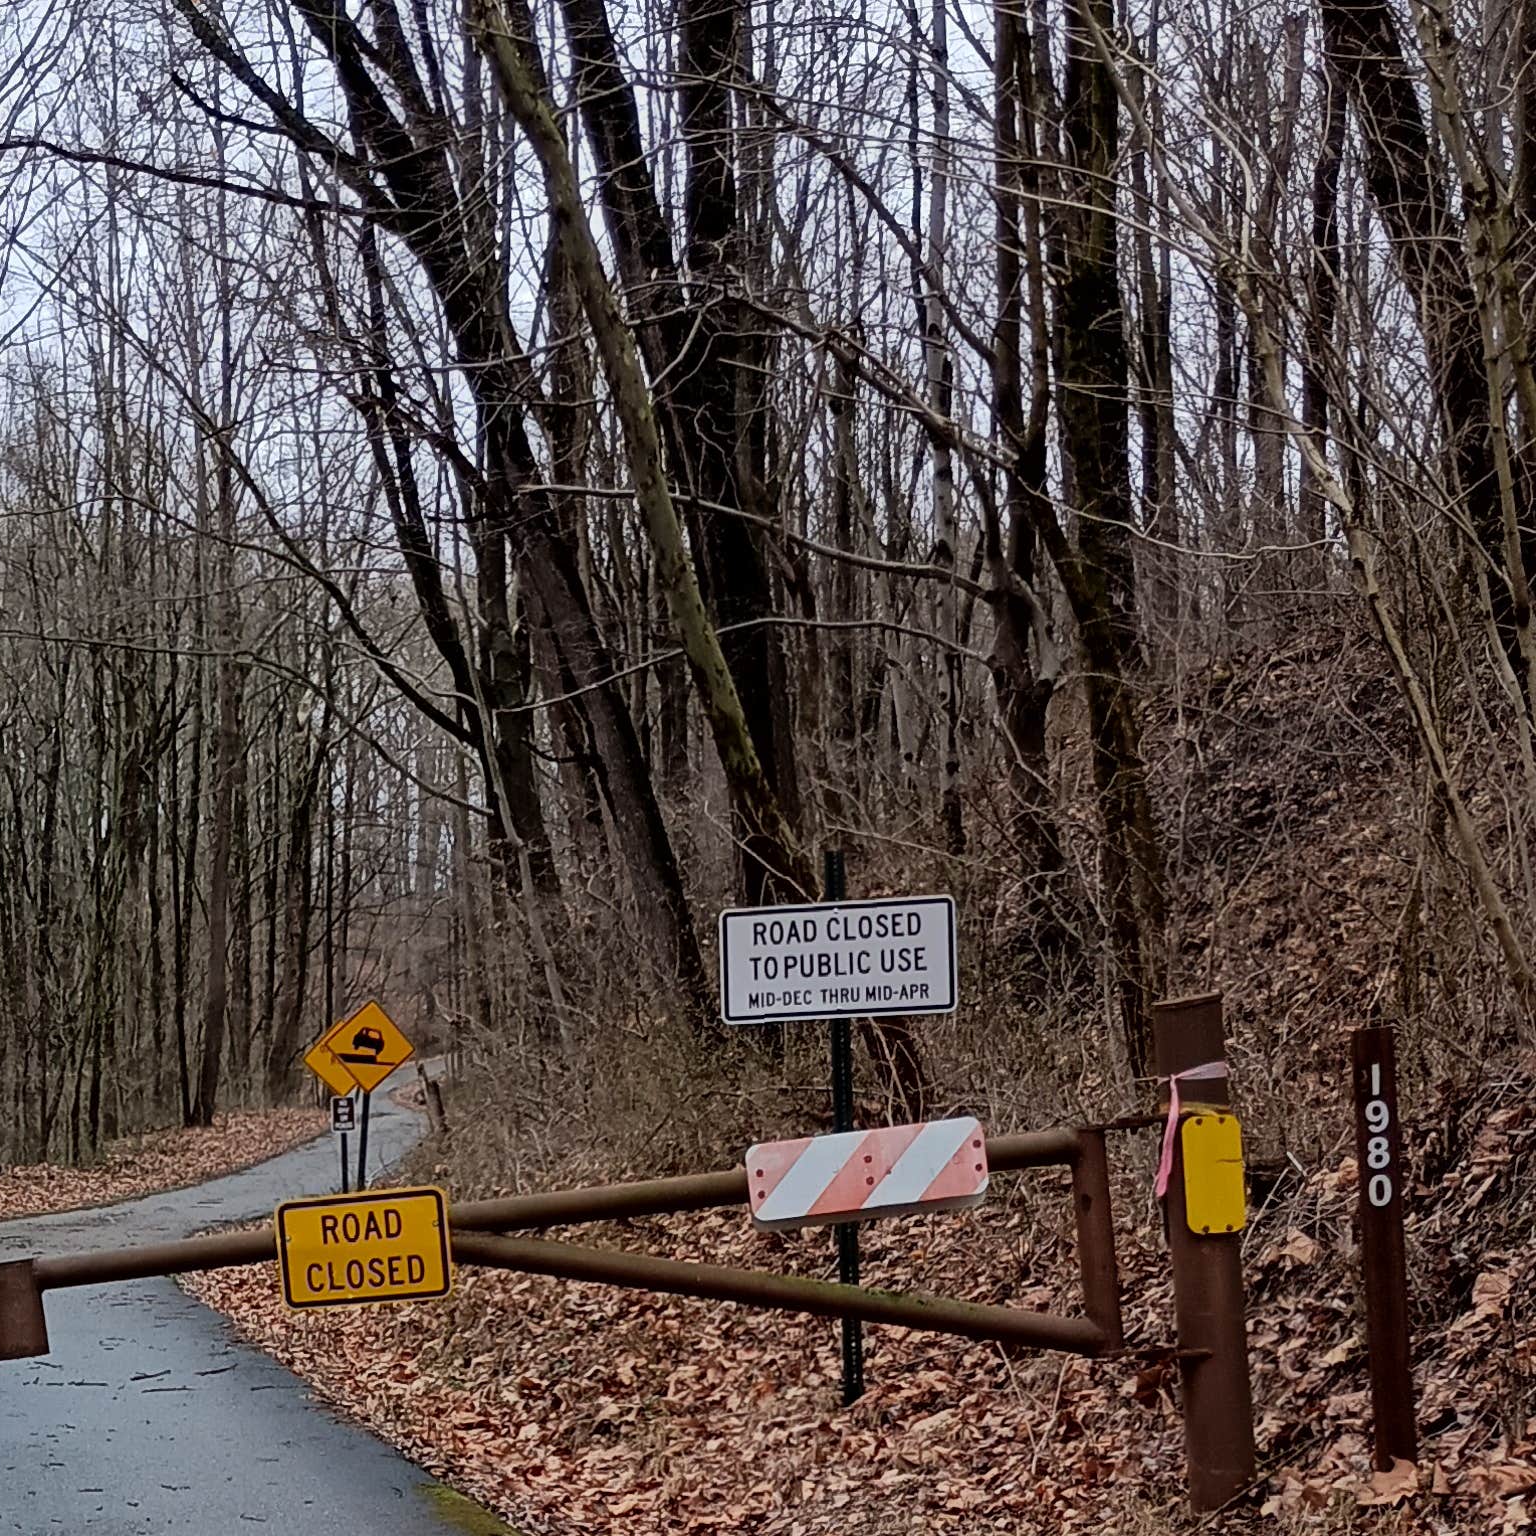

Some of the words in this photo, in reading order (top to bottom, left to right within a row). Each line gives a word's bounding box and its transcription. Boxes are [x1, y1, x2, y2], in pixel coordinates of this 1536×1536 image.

[753, 919, 817, 946] ROAD
[826, 912, 922, 942] CLOSED
[749, 956, 779, 981] TO
[784, 950, 871, 979] PUBLIC
[880, 947, 928, 973] USE
[748, 990, 813, 1009] MID-DEC
[820, 987, 861, 1004] THRU
[865, 983, 930, 1002] MID-APR
[1364, 1063, 1393, 1207] 1980
[321, 1208, 402, 1245] ROAD
[306, 1254, 426, 1293] CLOSED
